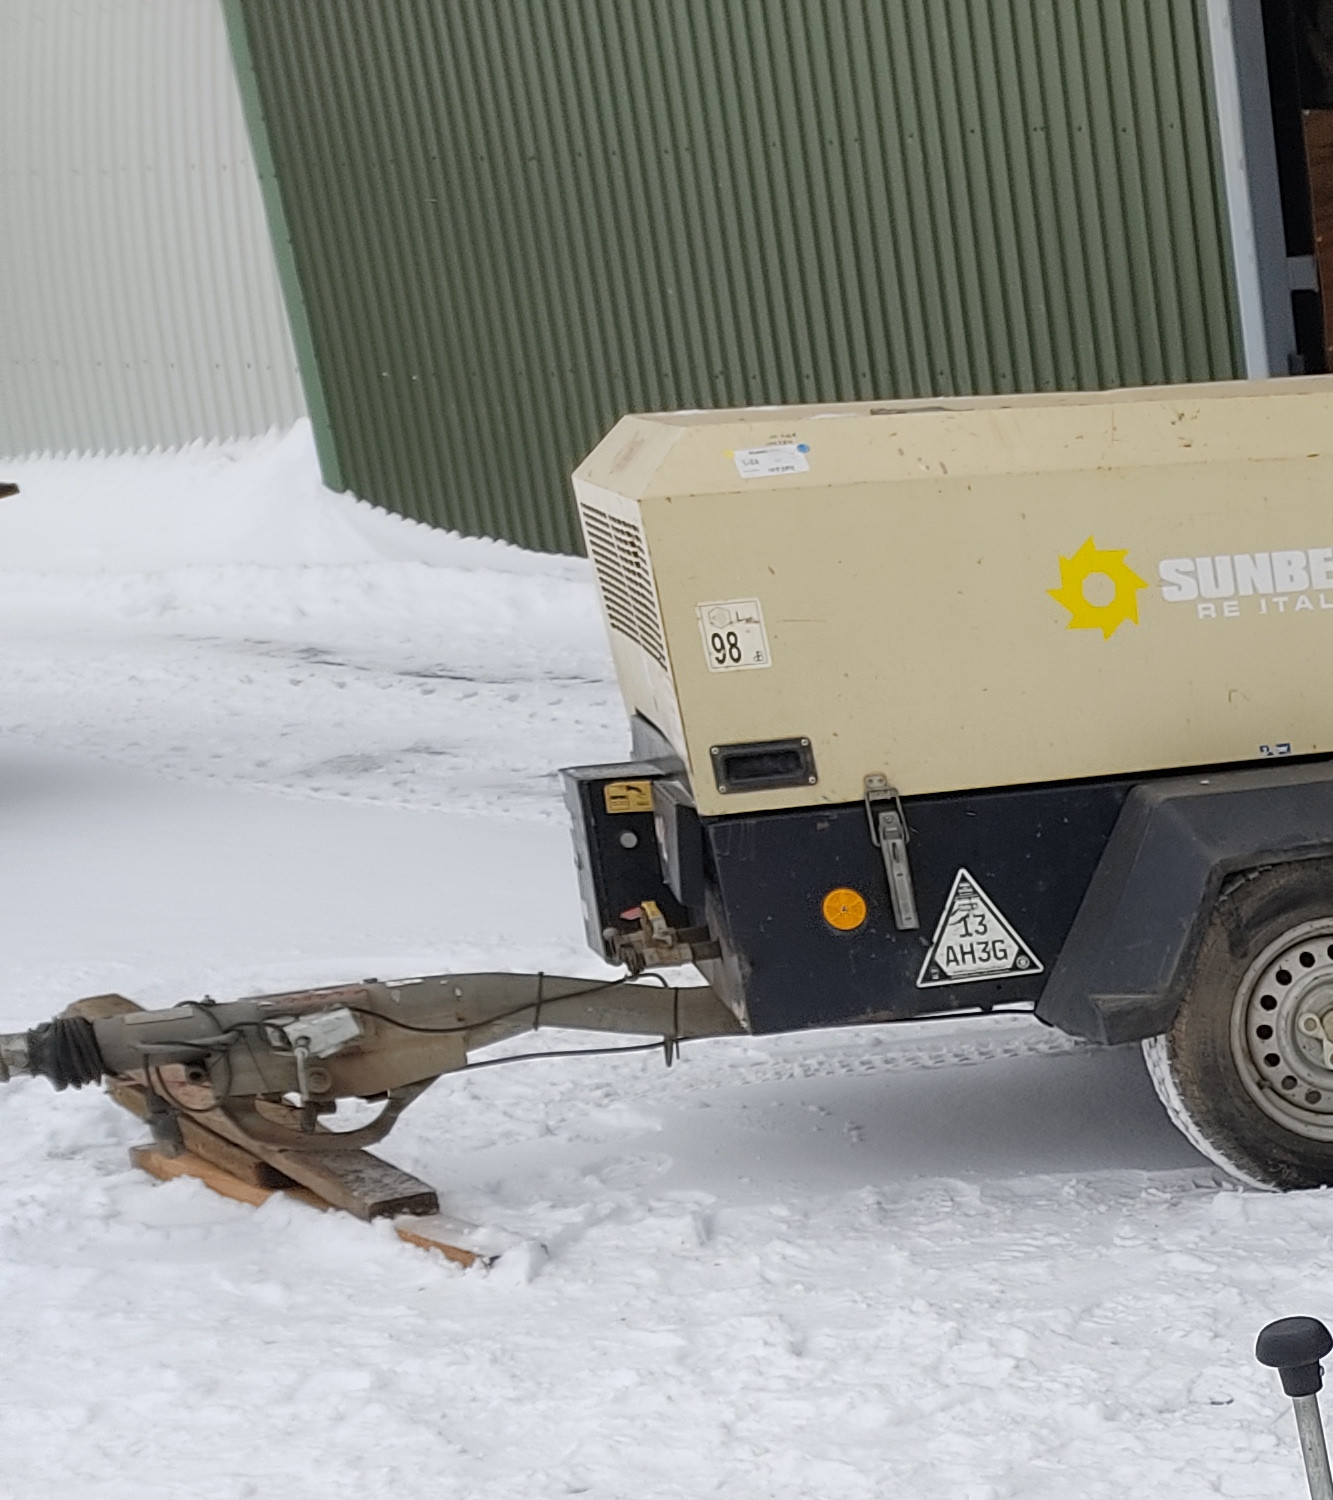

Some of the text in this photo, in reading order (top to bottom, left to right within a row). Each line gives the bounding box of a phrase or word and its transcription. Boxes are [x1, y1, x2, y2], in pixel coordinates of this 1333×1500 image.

[711, 631, 741, 664] 98
[959, 913, 988, 938] 13
[946, 939, 1008, 967] AH3G
